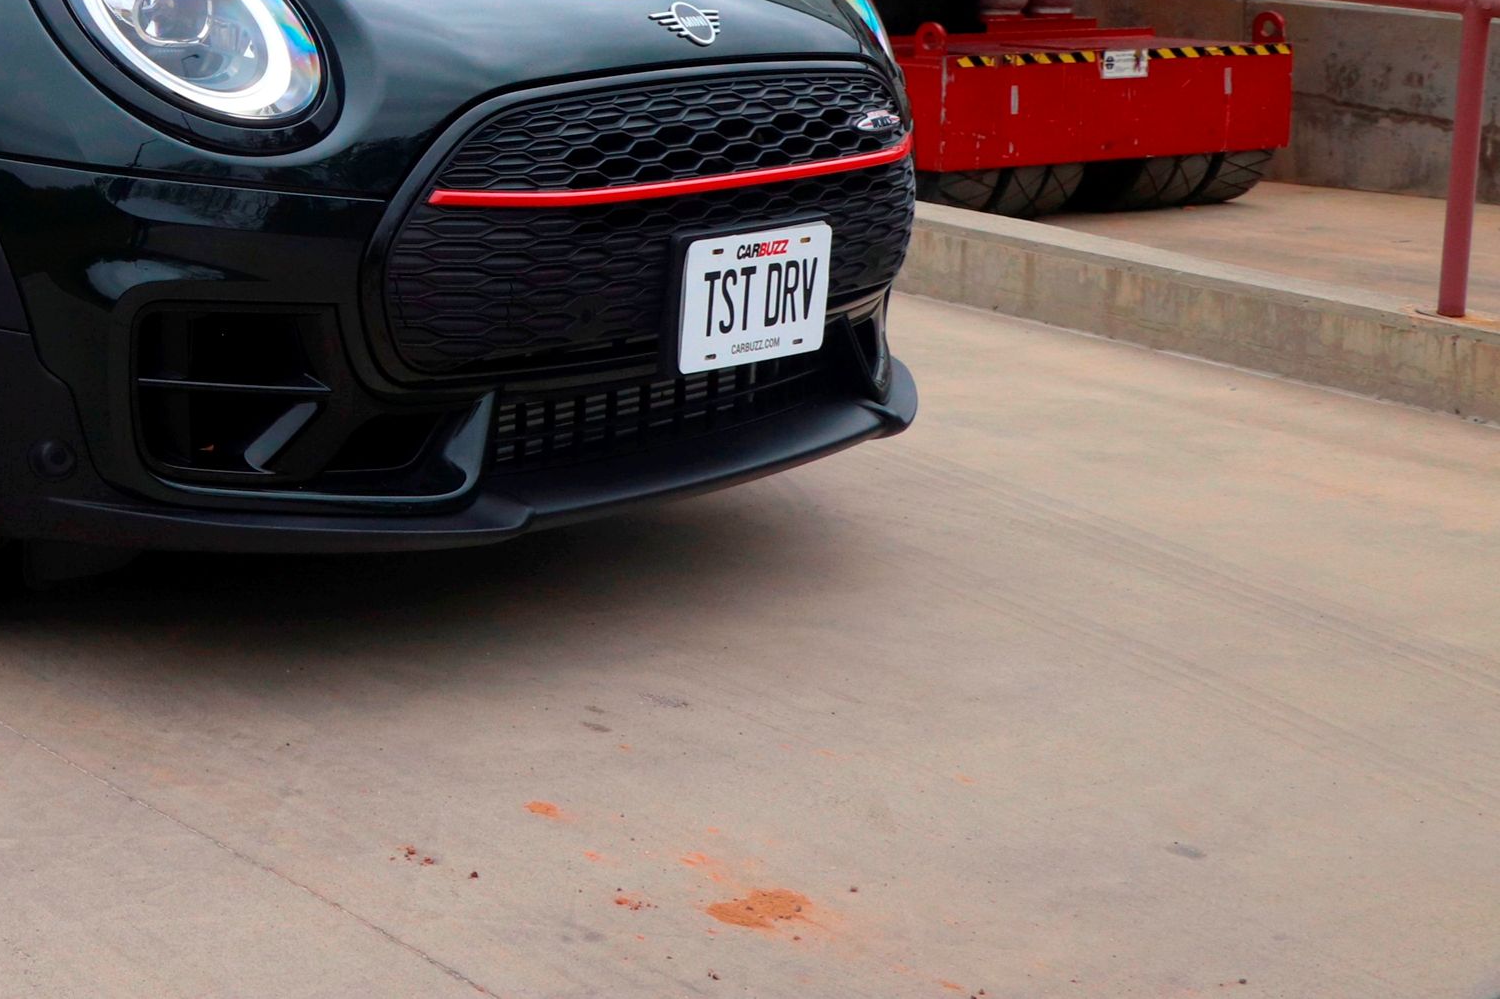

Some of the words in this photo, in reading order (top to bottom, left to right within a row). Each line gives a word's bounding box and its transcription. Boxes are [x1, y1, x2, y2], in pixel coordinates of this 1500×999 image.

[737, 239, 789, 260] CARBUZZ
[704, 266, 757, 337] TST
[764, 257, 818, 327] DRV
[731, 337, 780, 354] CARBUZZ.COM
